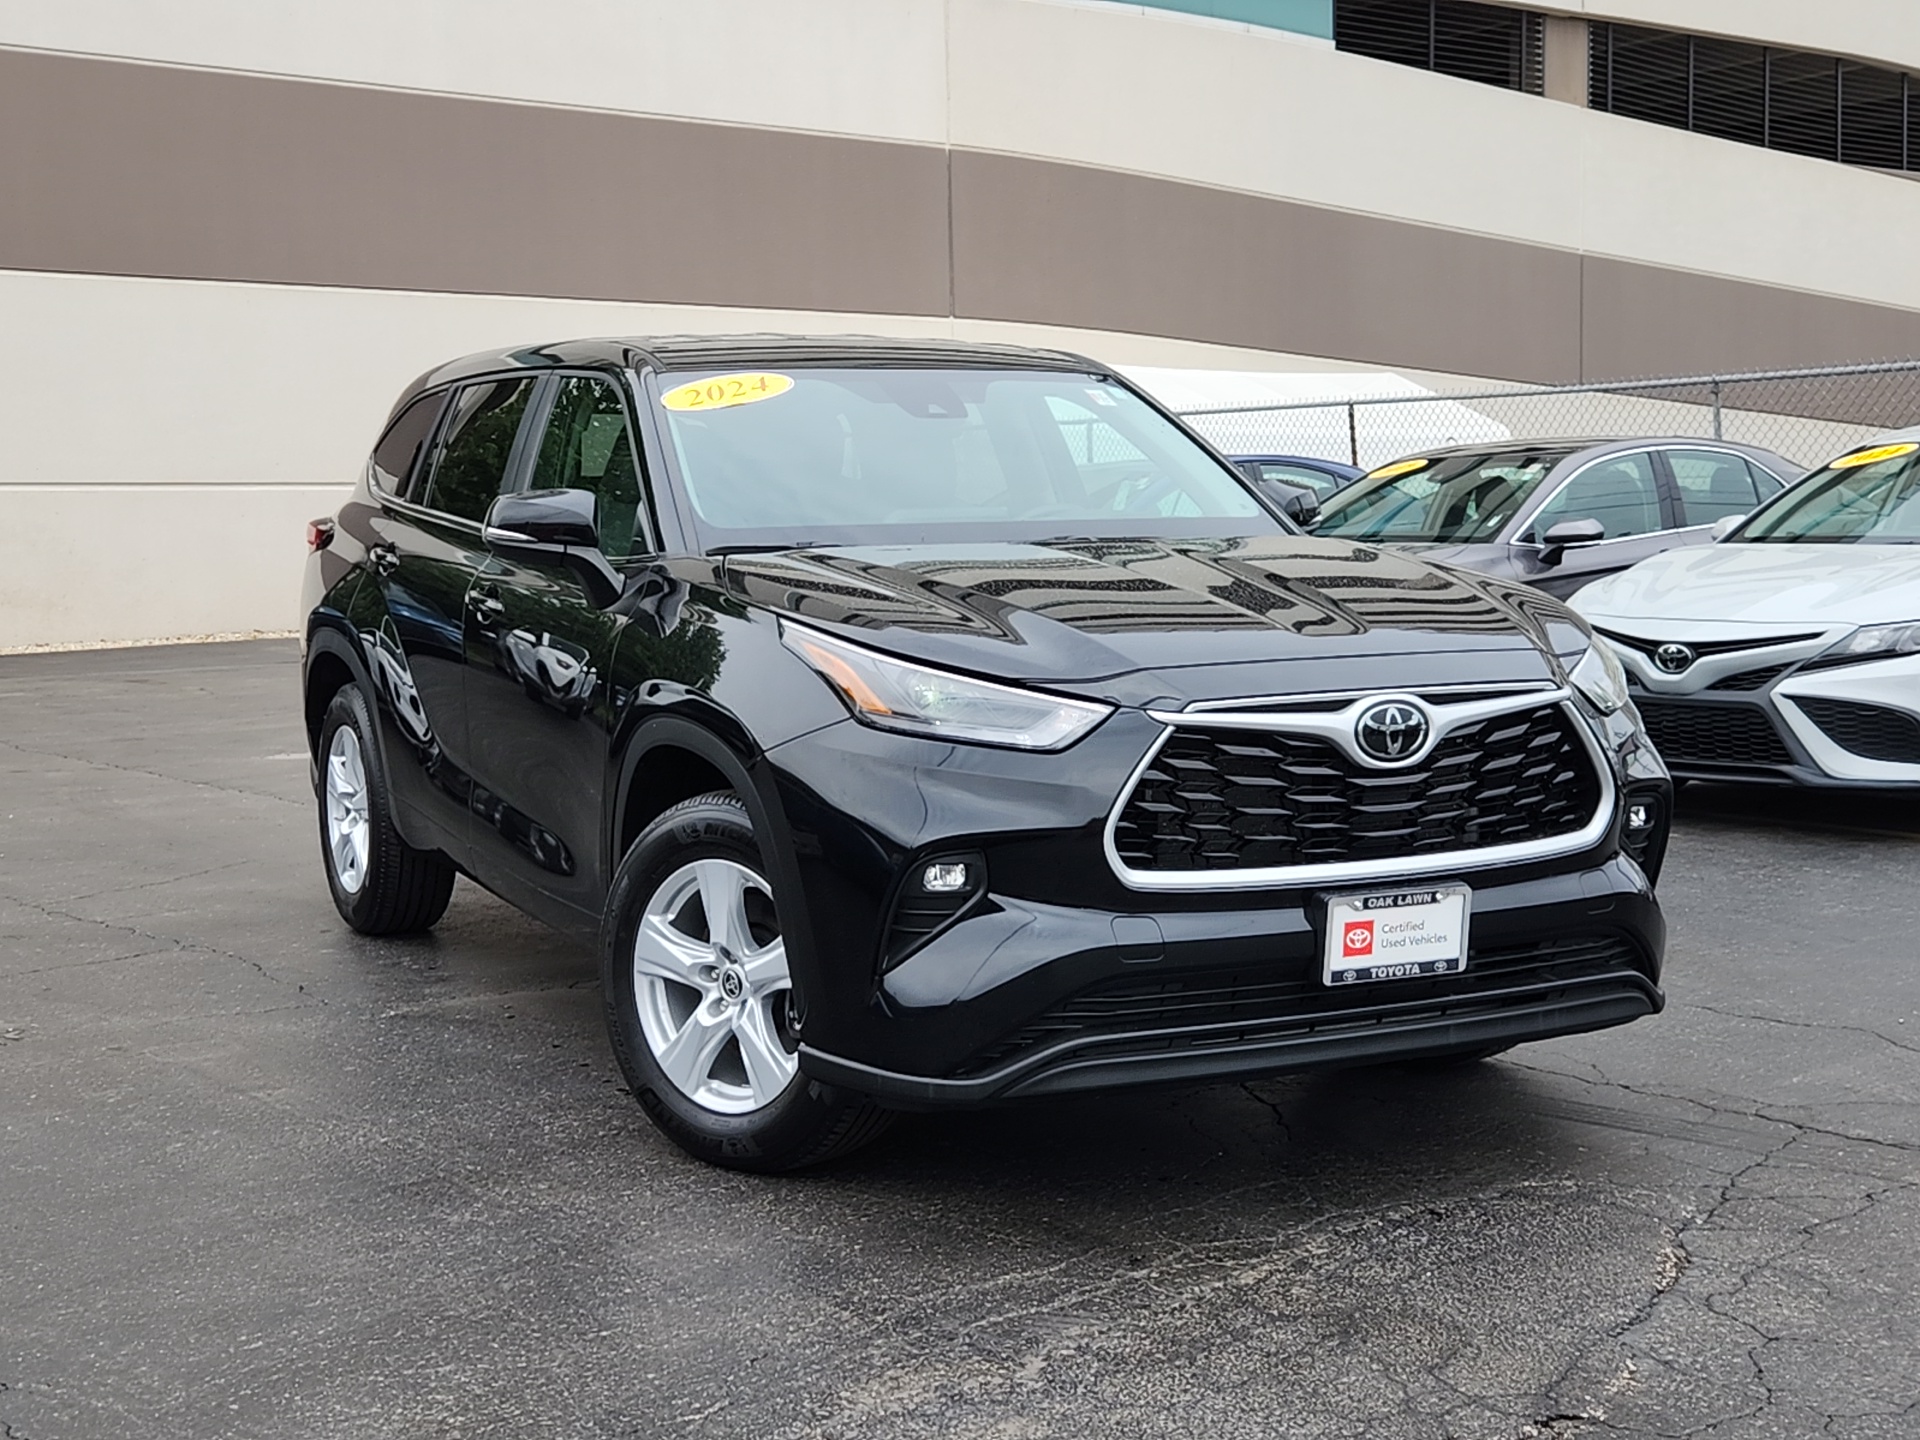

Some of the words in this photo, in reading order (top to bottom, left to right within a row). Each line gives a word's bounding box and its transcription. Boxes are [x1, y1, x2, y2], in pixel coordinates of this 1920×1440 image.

[684, 376, 769, 407] 2024
[1367, 896, 1394, 908] OAK
[1397, 893, 1433, 906] LAWN
[1381, 920, 1425, 934] Certified
[1381, 936, 1406, 949] Used
[1408, 933, 1448, 947] Vehicles
[1369, 964, 1421, 979] TOYOTA
